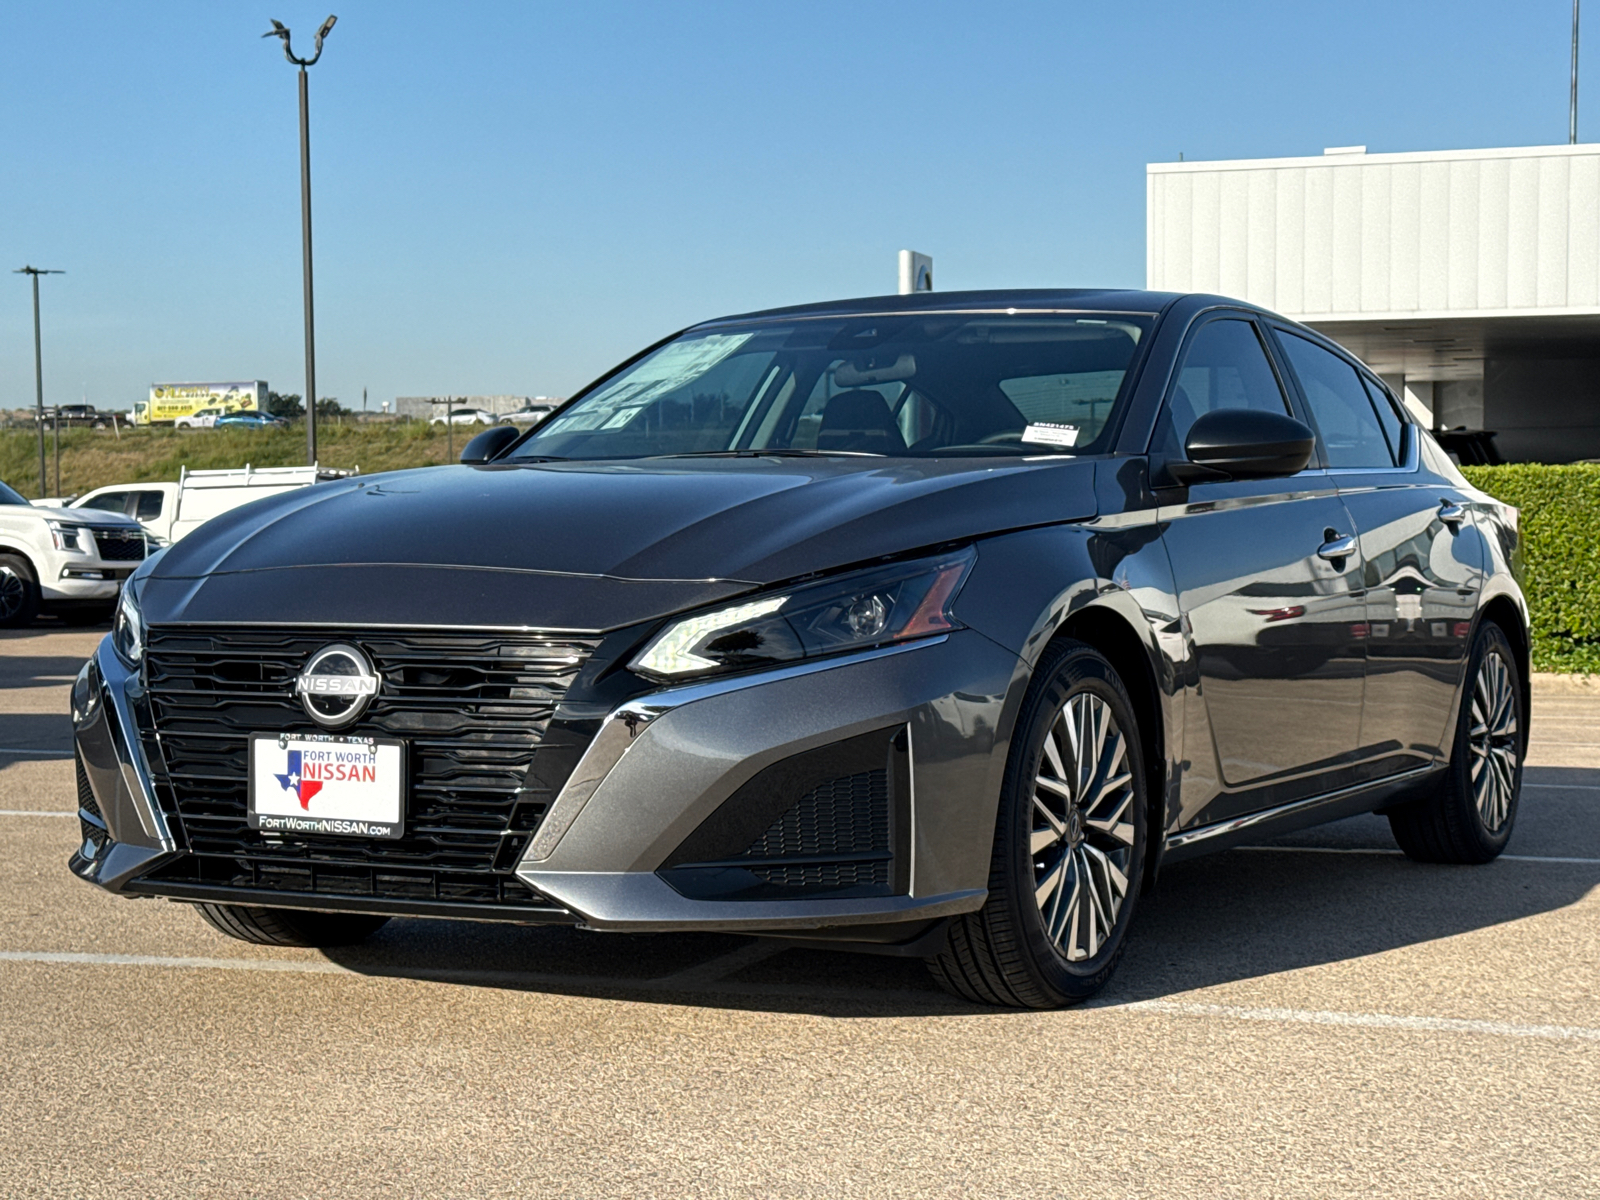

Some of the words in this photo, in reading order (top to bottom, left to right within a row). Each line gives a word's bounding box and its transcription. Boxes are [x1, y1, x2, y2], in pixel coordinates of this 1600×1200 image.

[298, 677, 374, 692] NISSAN
[279, 733, 301, 742] FORT
[304, 734, 335, 743] WORTH
[346, 736, 374, 745] TEXAS
[303, 750, 332, 762] FORT
[335, 751, 376, 764] WORTH
[303, 762, 376, 783] NISSAN
